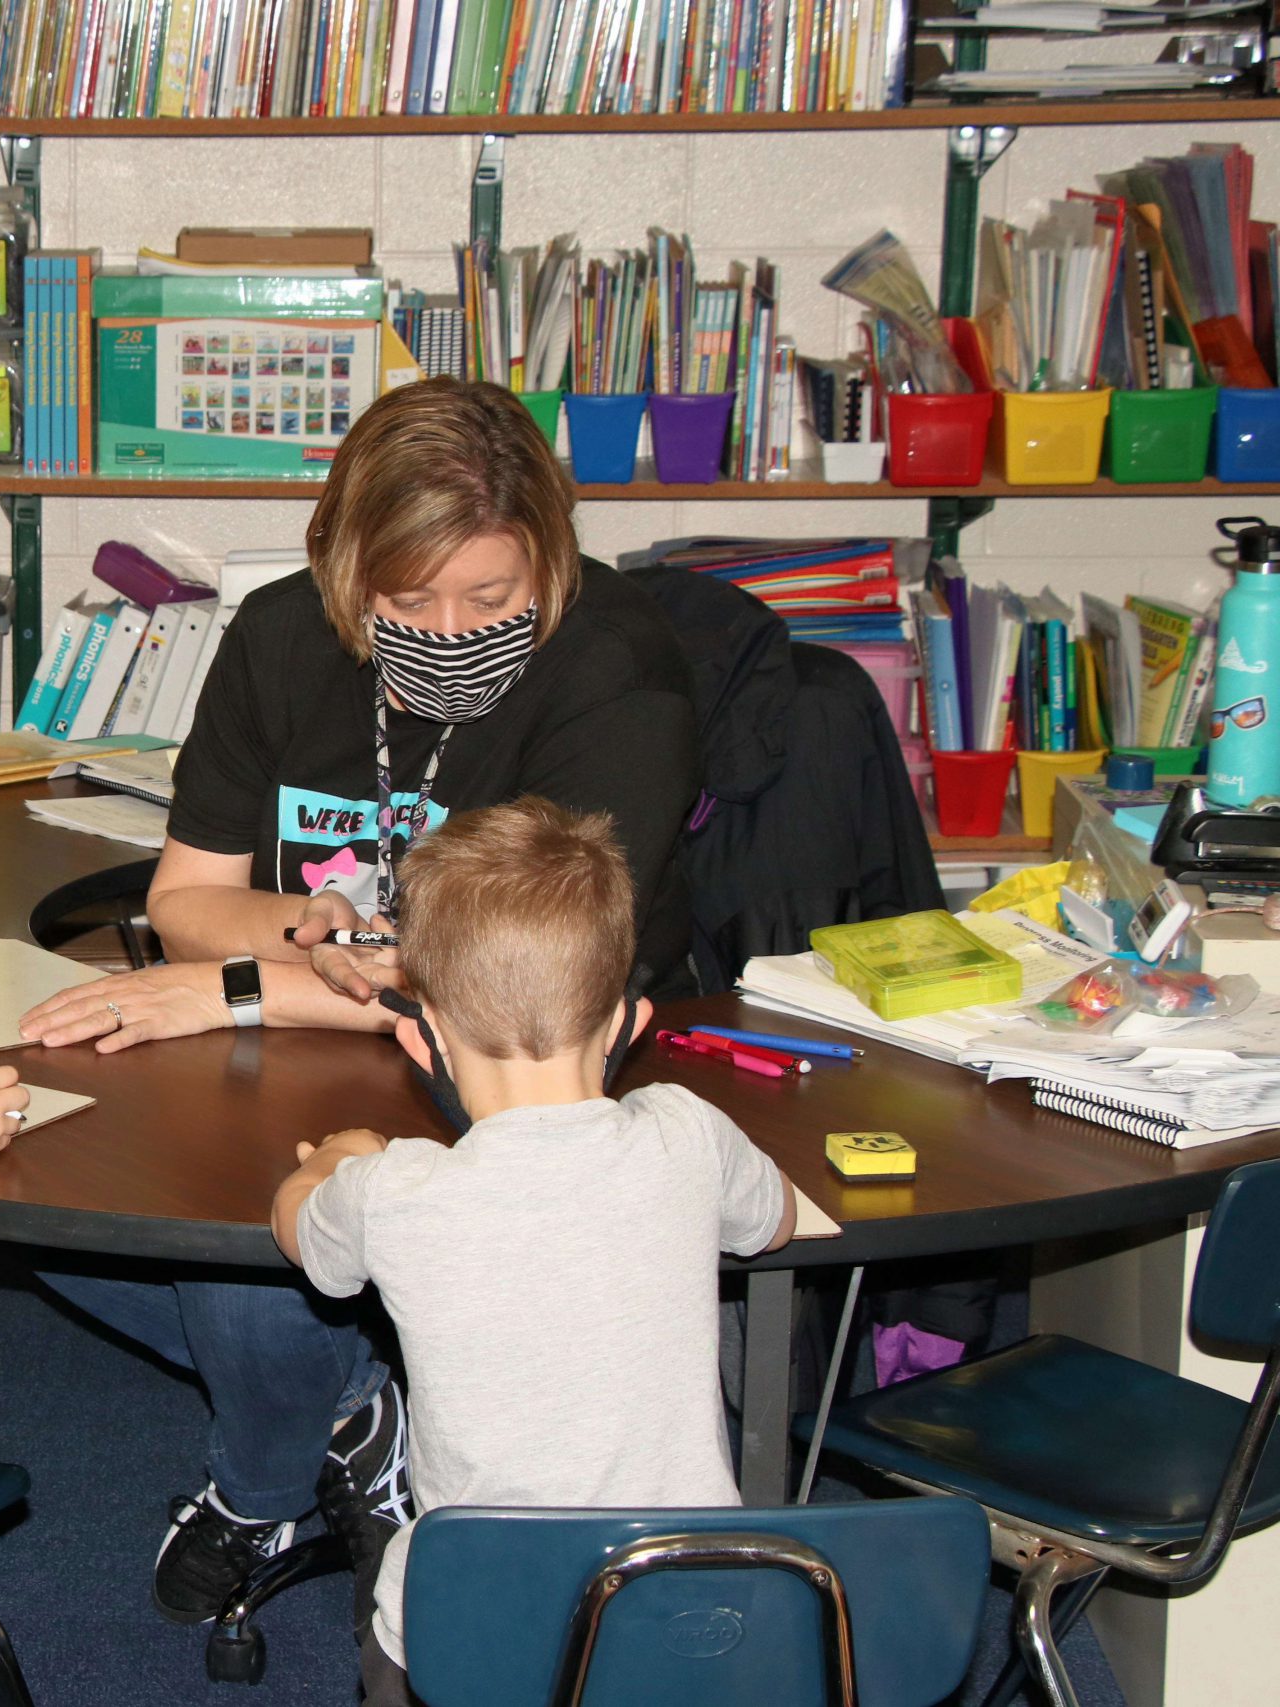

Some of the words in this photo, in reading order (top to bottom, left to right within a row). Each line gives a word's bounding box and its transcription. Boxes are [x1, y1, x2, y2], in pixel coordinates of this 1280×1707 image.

[115, 330, 143, 344] 28
[47, 633, 73, 688] phonics
[76, 622, 108, 681] phonics
[1052, 675, 1063, 709] poetry
[297, 804, 365, 836] WE'RE
[355, 931, 383, 943] EXPO
[1050, 940, 1098, 963] Monitoring
